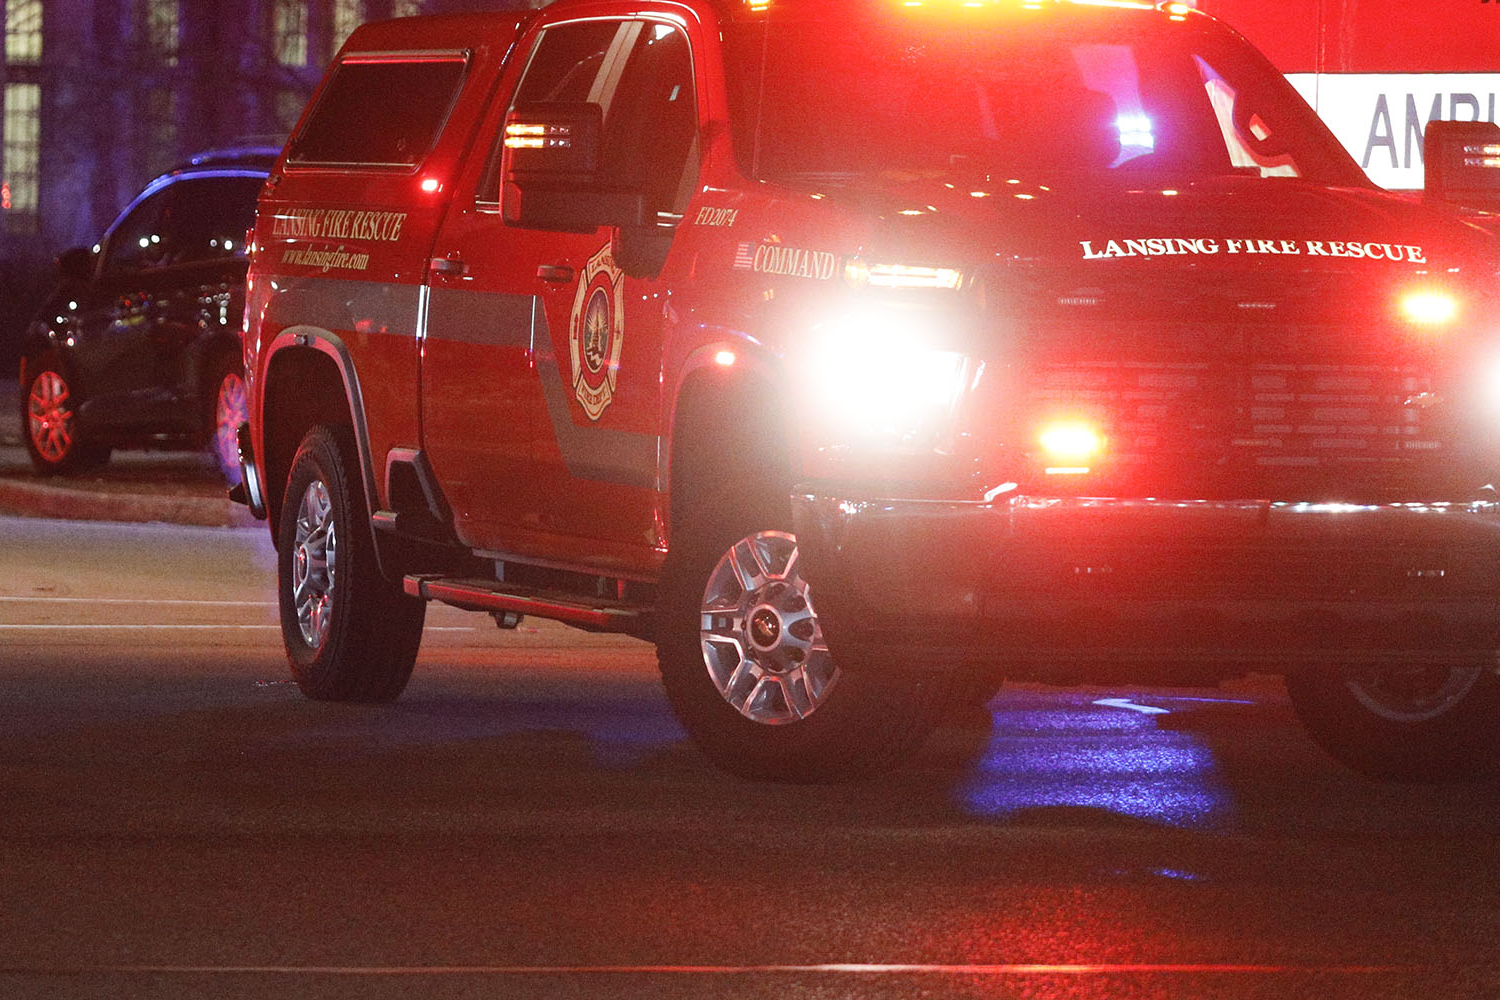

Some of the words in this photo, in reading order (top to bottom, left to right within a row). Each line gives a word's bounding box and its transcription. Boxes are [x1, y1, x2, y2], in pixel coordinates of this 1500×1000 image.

[1362, 92, 1496, 169] AM
[272, 208, 324, 237] LANSING
[321, 209, 355, 239] FIRE
[350, 211, 407, 242] RESCUE
[694, 206, 739, 227] FD2074
[281, 243, 369, 273] www.lansingfire.com
[753, 244, 836, 281] COMMAND
[1079, 238, 1220, 260] LANSING
[1223, 238, 1300, 255] FIRE
[1304, 240, 1428, 264] RESCUE
